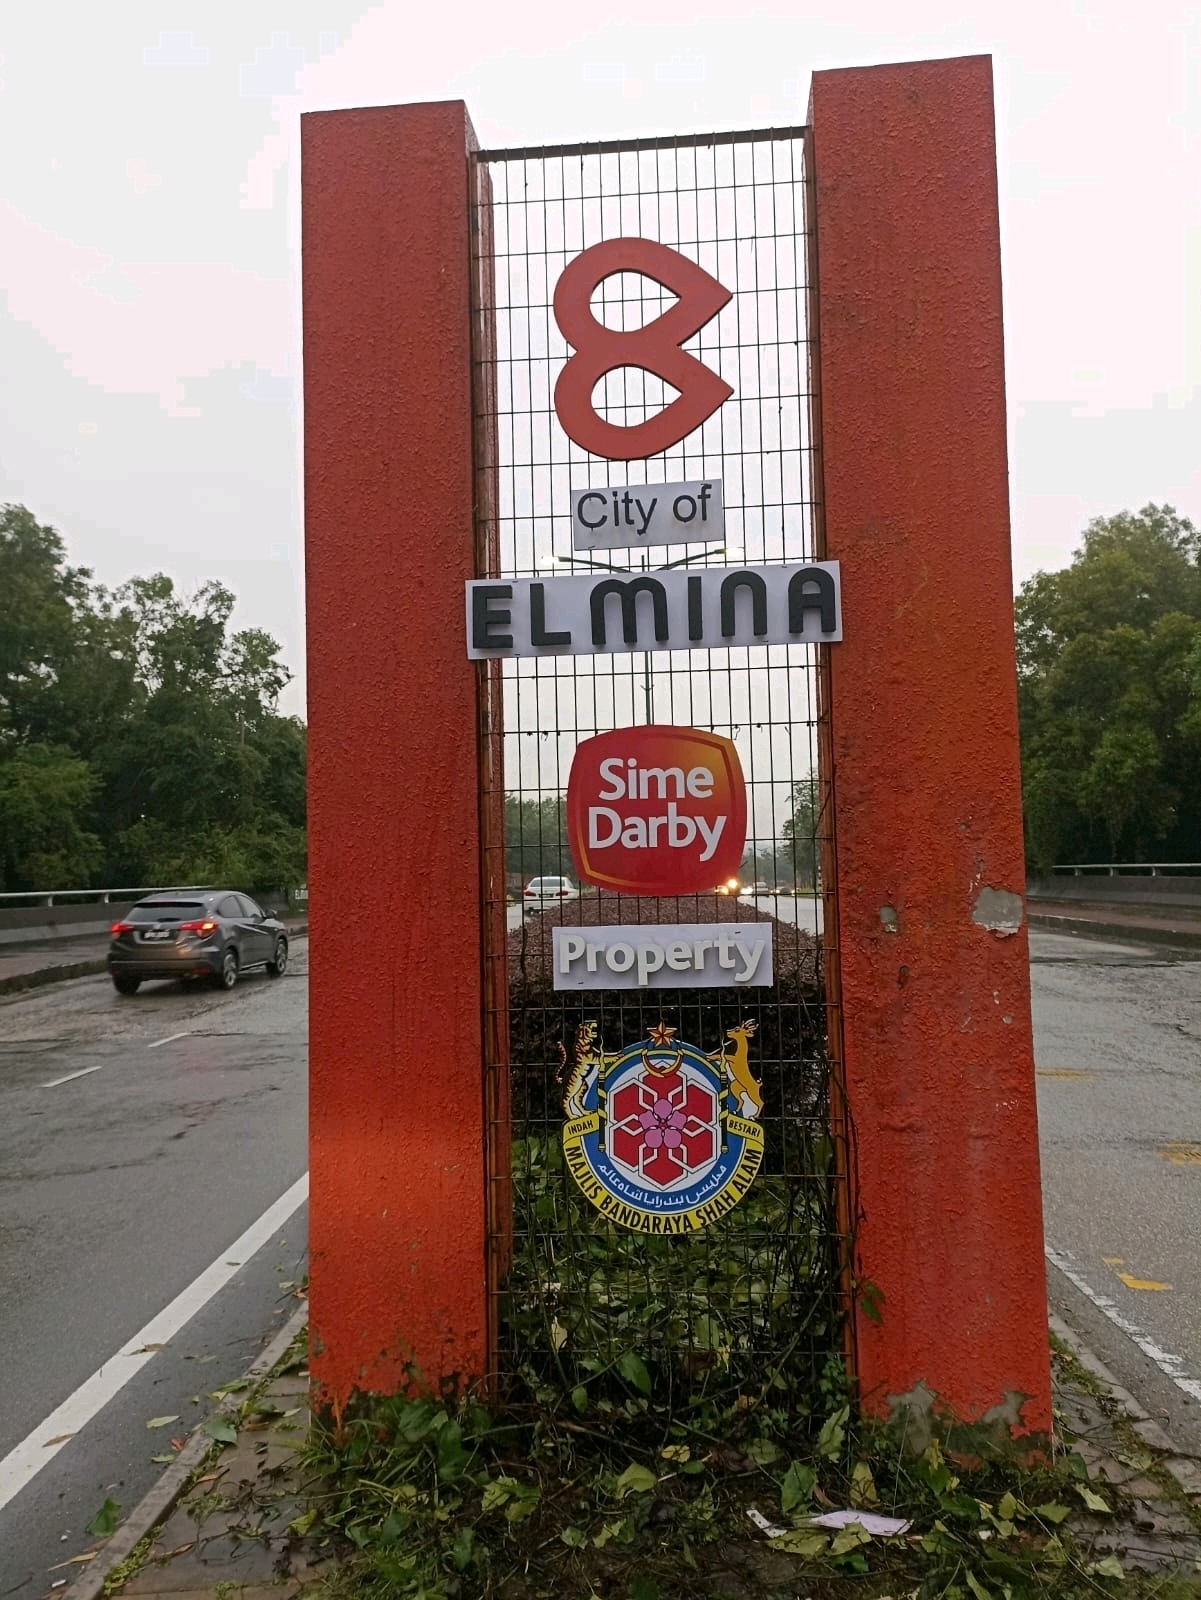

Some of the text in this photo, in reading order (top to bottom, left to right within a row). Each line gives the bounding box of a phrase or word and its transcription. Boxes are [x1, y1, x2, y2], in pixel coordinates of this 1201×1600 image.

[577, 484, 712, 537] City of
[472, 567, 836, 649] ELMINA
[598, 757, 715, 801] Sime
[588, 802, 727, 861] Darby
[558, 931, 766, 986] Property
[567, 1119, 594, 1135] INDAH
[728, 1119, 761, 1137] BESTARI
[565, 1146, 763, 1234] MAJLIS BANDARAYA SHAH ALAM
